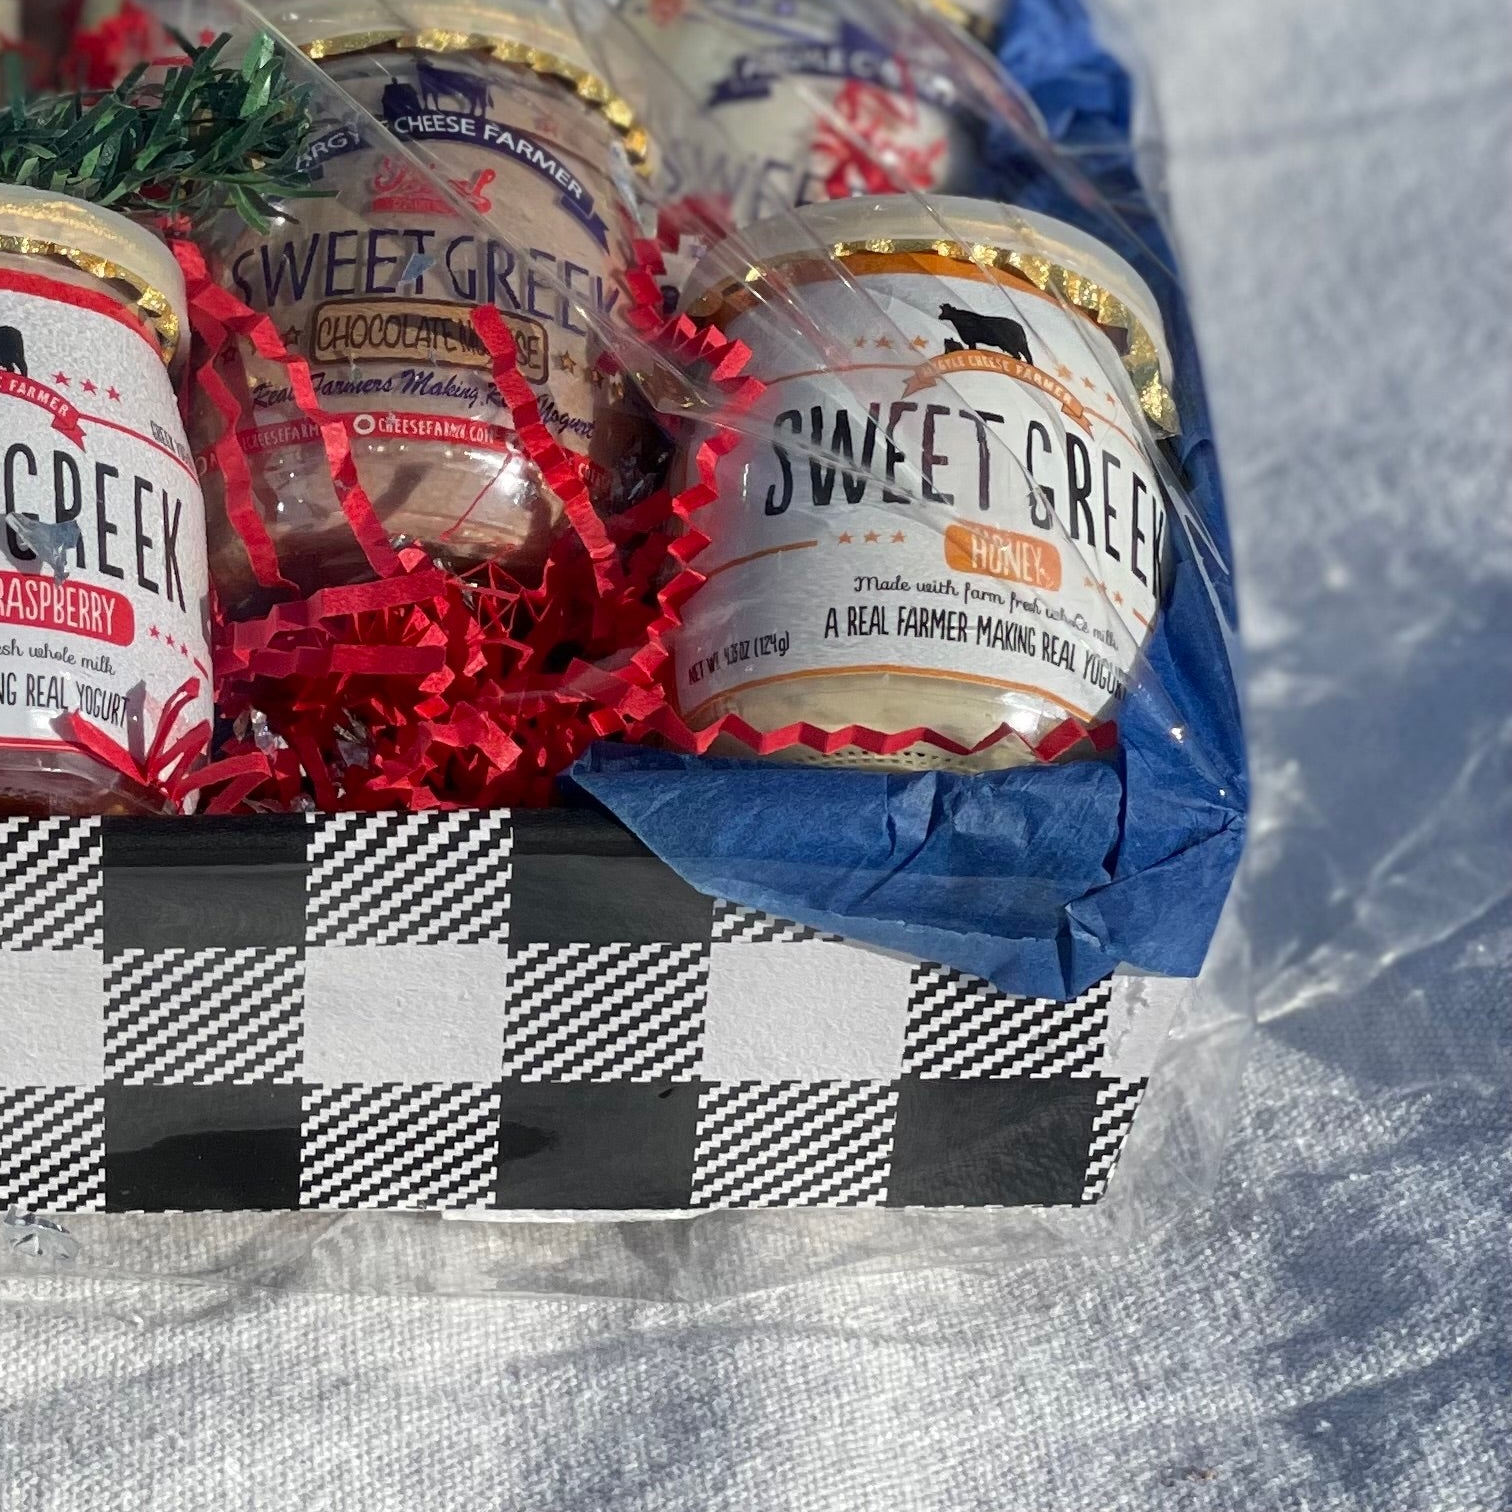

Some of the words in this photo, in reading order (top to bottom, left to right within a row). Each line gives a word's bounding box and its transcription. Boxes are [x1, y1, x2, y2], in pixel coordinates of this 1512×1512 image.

[394, 113, 477, 137] CHEESE
[483, 121, 583, 200] FARMER
[232, 228, 436, 307] SWEET
[315, 312, 457, 354] CHOCOLATE
[8, 378, 69, 417] FARMER
[312, 371, 393, 397] Farmers
[967, 355, 1012, 373] CHEESE
[1015, 364, 1073, 406] FARMER
[764, 402, 1005, 516] SWEET
[3, 441, 187, 614] GREEK
[971, 534, 1044, 586] HONEY
[853, 574, 911, 593] Made
[915, 576, 960, 598] with
[963, 581, 1006, 606] farm
[28, 644, 77, 666] whole
[80, 654, 117, 677] milk
[753, 629, 791, 657] (124g)
[823, 606, 839, 640] A
[846, 604, 890, 638] REAL
[896, 605, 969, 644] FARMER
[975, 613, 1037, 658] MAKING
[1041, 630, 1077, 673] REAL
[25, 672, 70, 711] REAL
[75, 680, 131, 729] YOGURT
